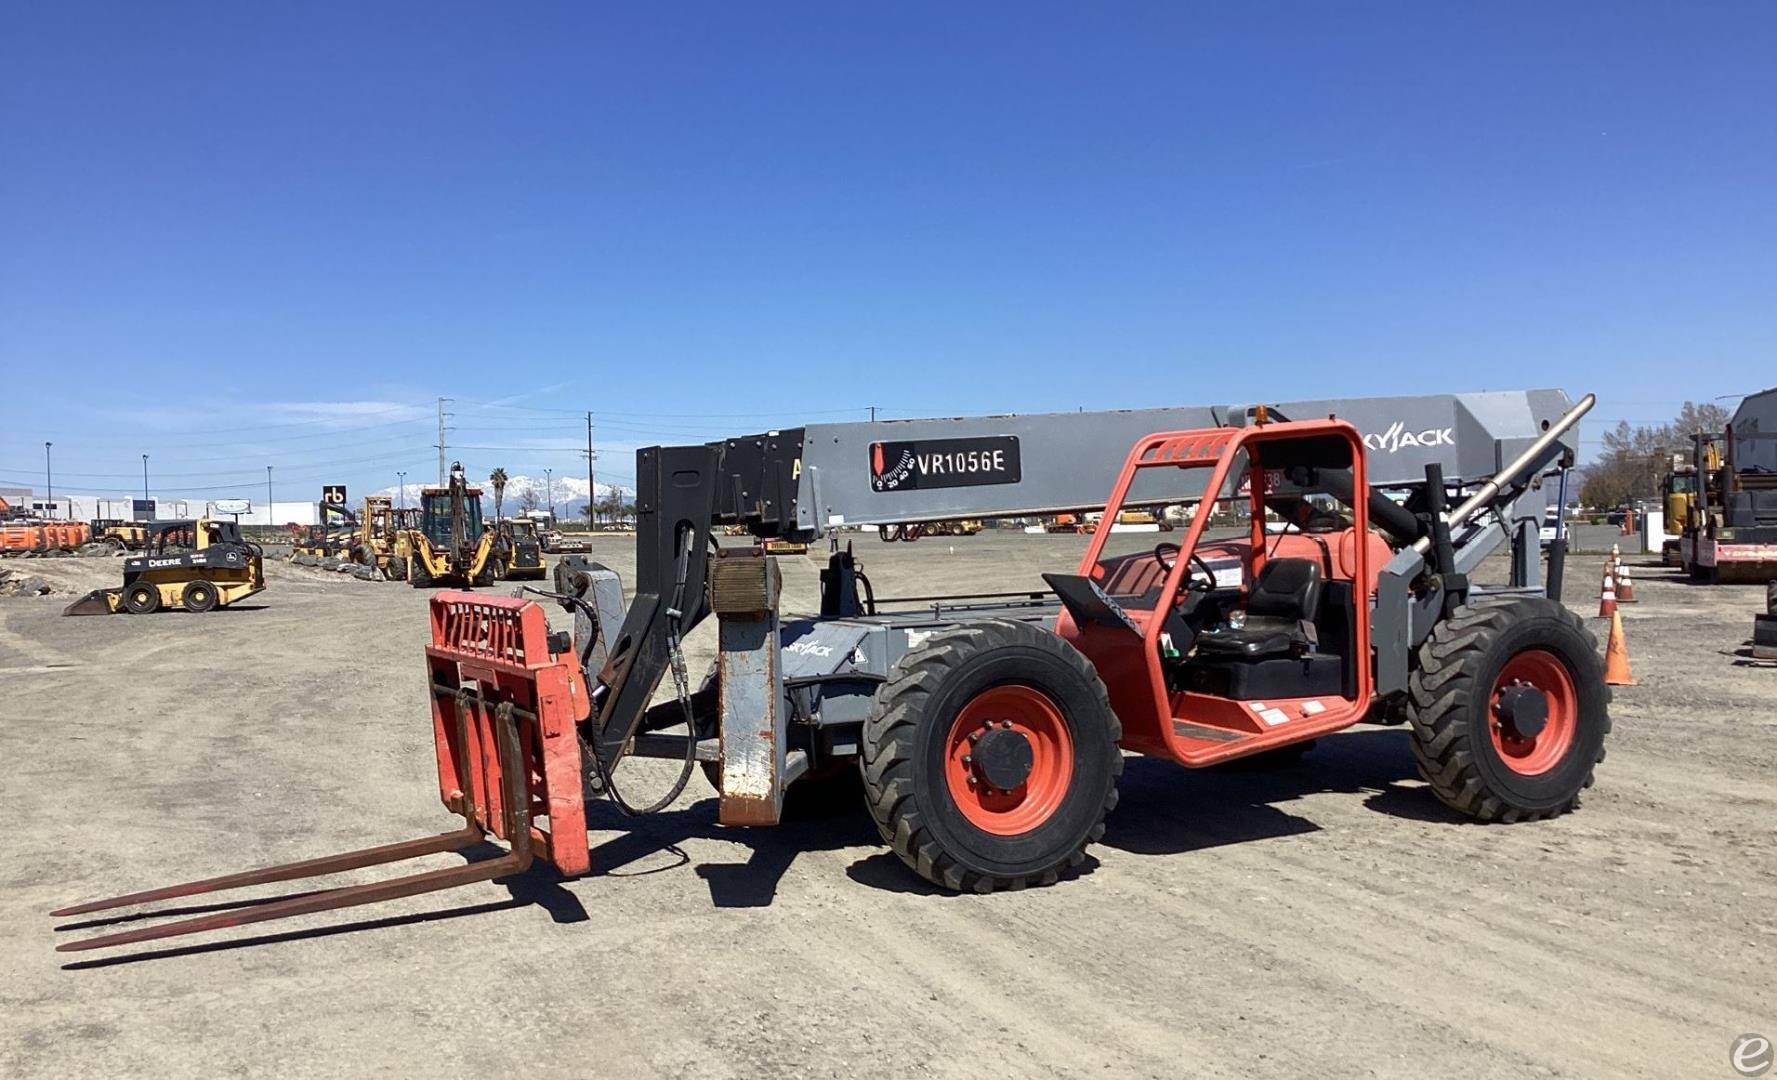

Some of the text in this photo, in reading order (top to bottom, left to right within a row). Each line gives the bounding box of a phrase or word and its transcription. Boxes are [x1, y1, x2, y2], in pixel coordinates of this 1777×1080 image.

[1363, 421, 1456, 453] KYJACK
[917, 450, 1005, 475] VR1056E
[325, 486, 344, 504] rb
[148, 558, 182, 568] DEERE
